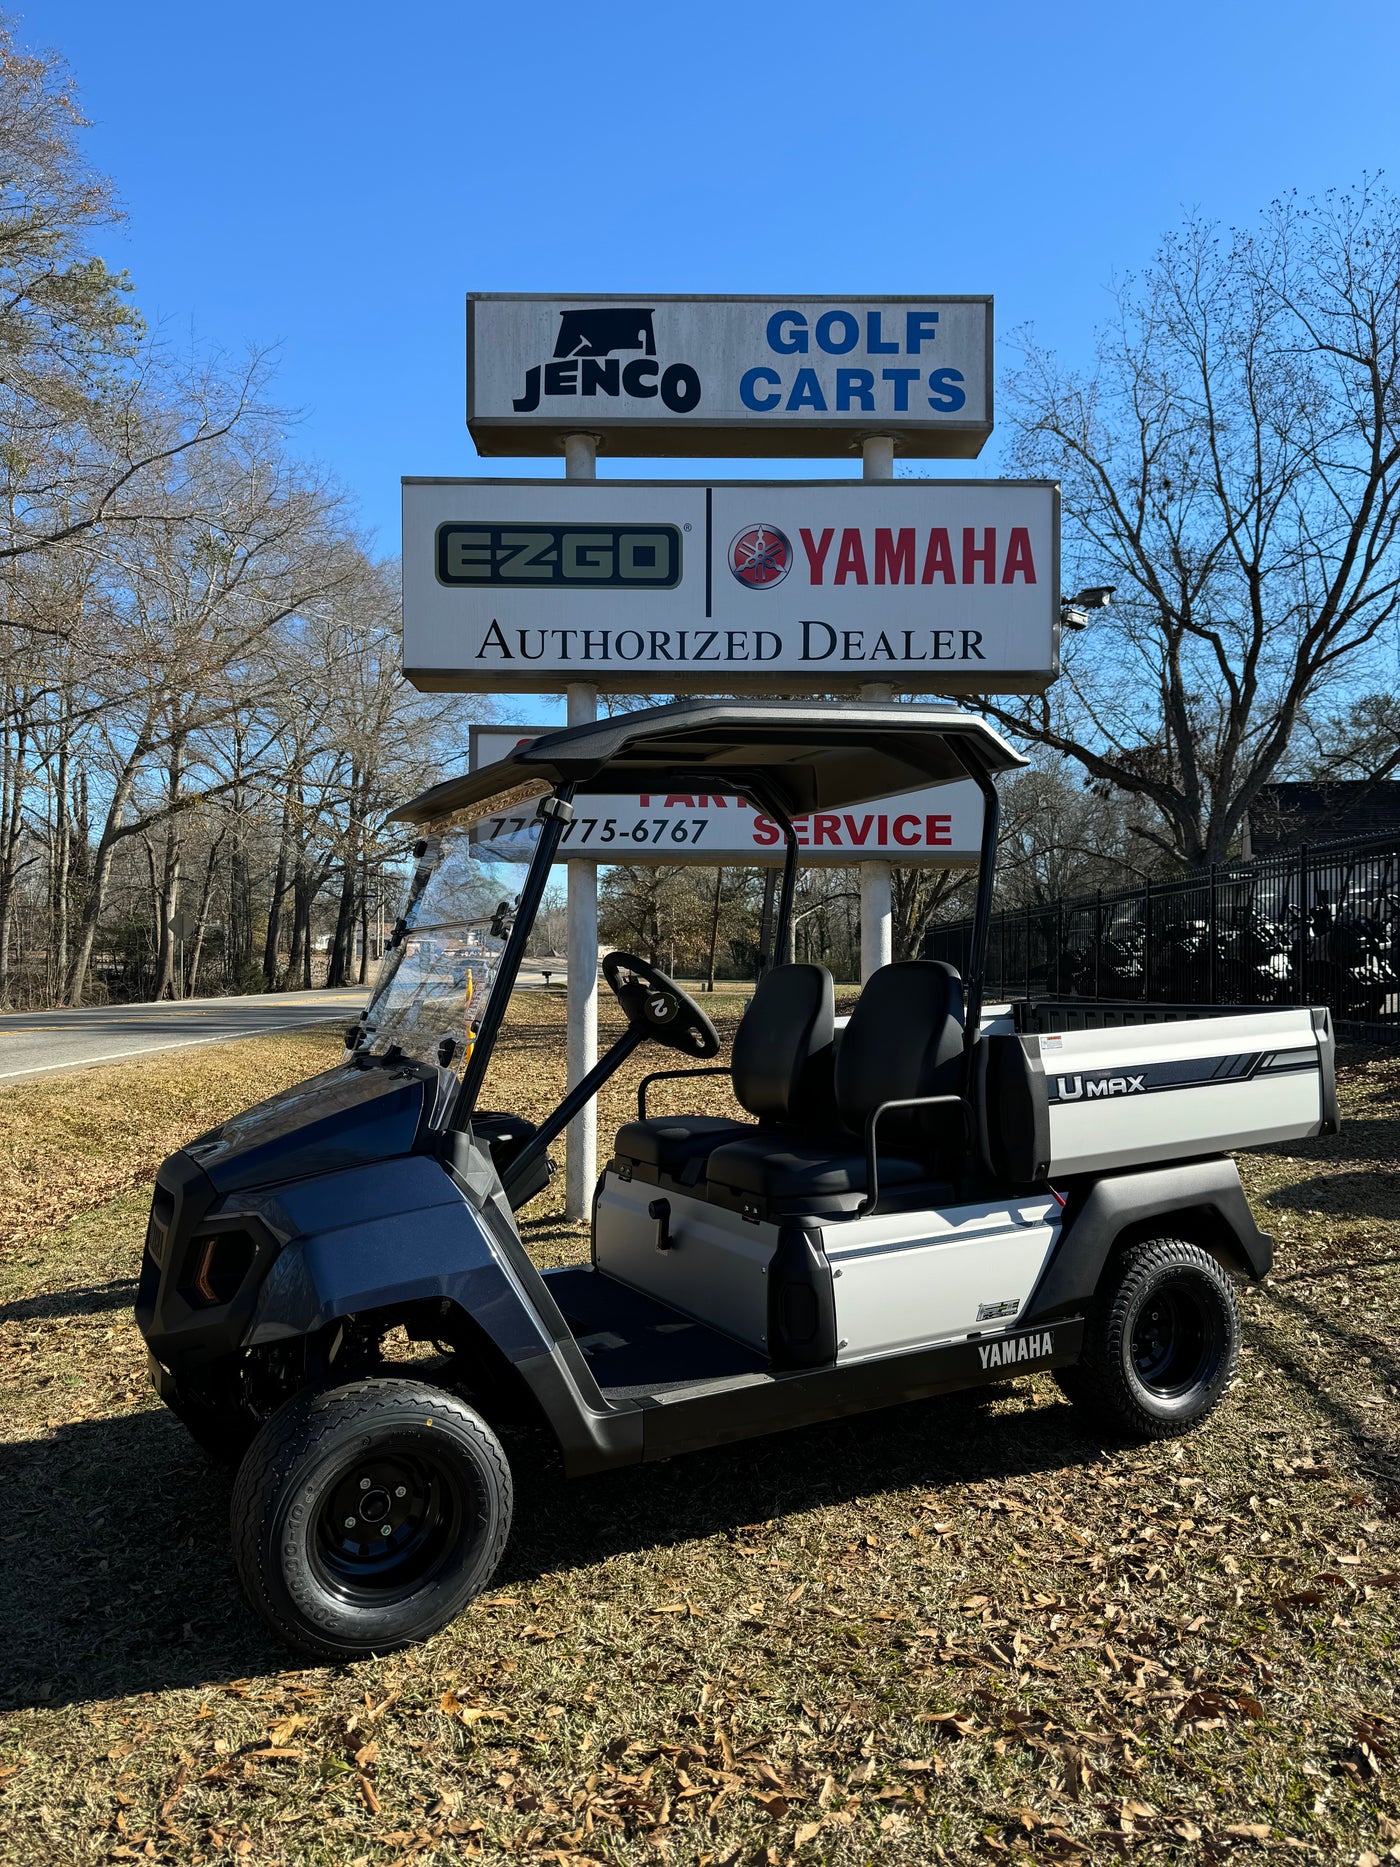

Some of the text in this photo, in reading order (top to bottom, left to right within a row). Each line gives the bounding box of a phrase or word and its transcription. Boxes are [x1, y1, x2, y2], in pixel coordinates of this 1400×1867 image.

[766, 310, 939, 354] GOLF
[512, 359, 701, 413] JENCO
[739, 367, 966, 412] CARTS
[447, 532, 670, 579] EZGO
[798, 527, 1037, 586] YAMAHA
[752, 814, 952, 846] SERVICE
[978, 1331, 1053, 1369] YAMAHA
